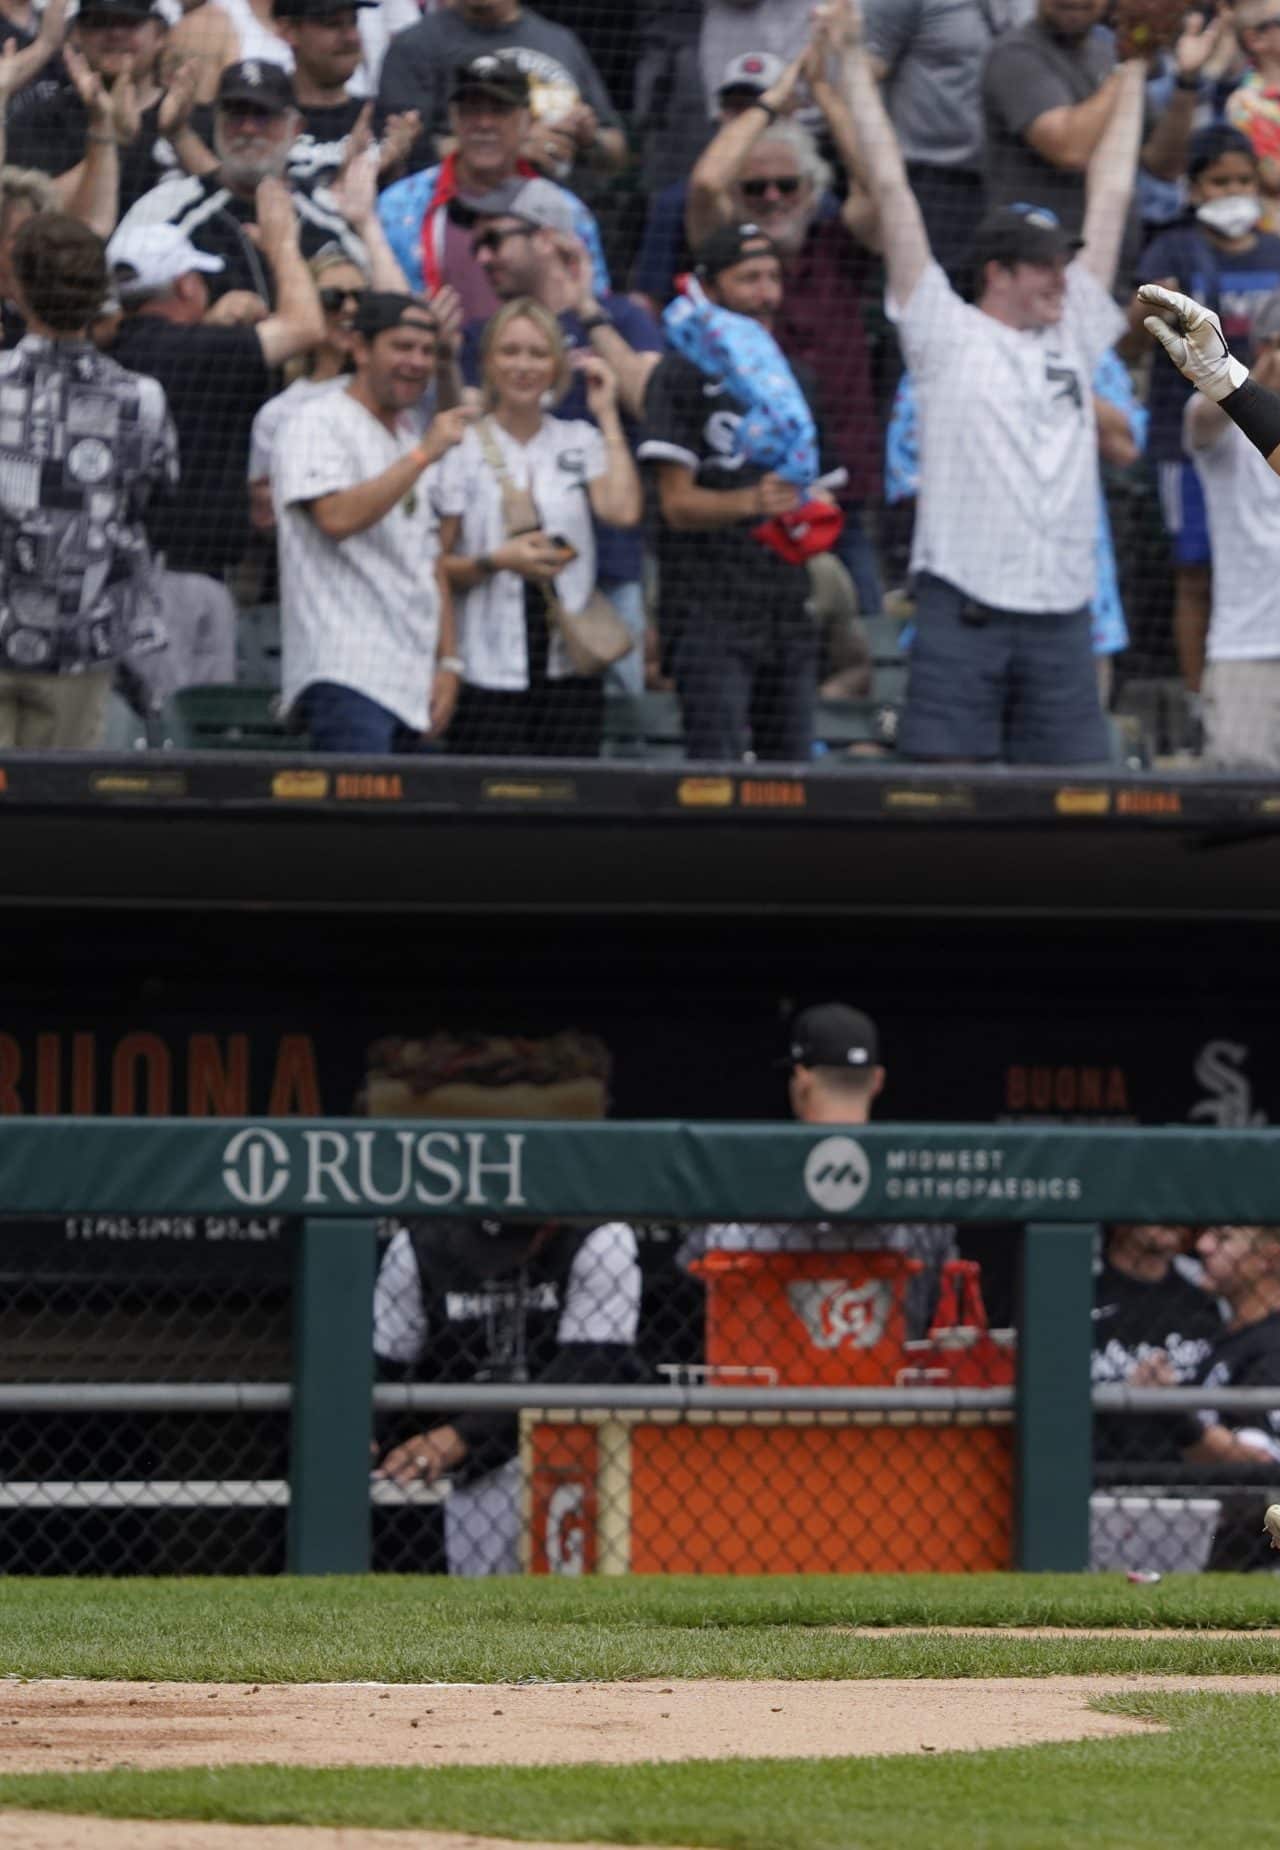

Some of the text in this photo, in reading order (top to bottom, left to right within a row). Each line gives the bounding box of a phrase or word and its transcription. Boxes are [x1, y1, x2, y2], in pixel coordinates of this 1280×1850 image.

[1007, 1065, 1129, 1110] BUONA
[303, 1130, 527, 1207] RUSH
[886, 1150, 1004, 1170] MIDWEST
[885, 1177, 1082, 1200] ORTHOPAEDICS
